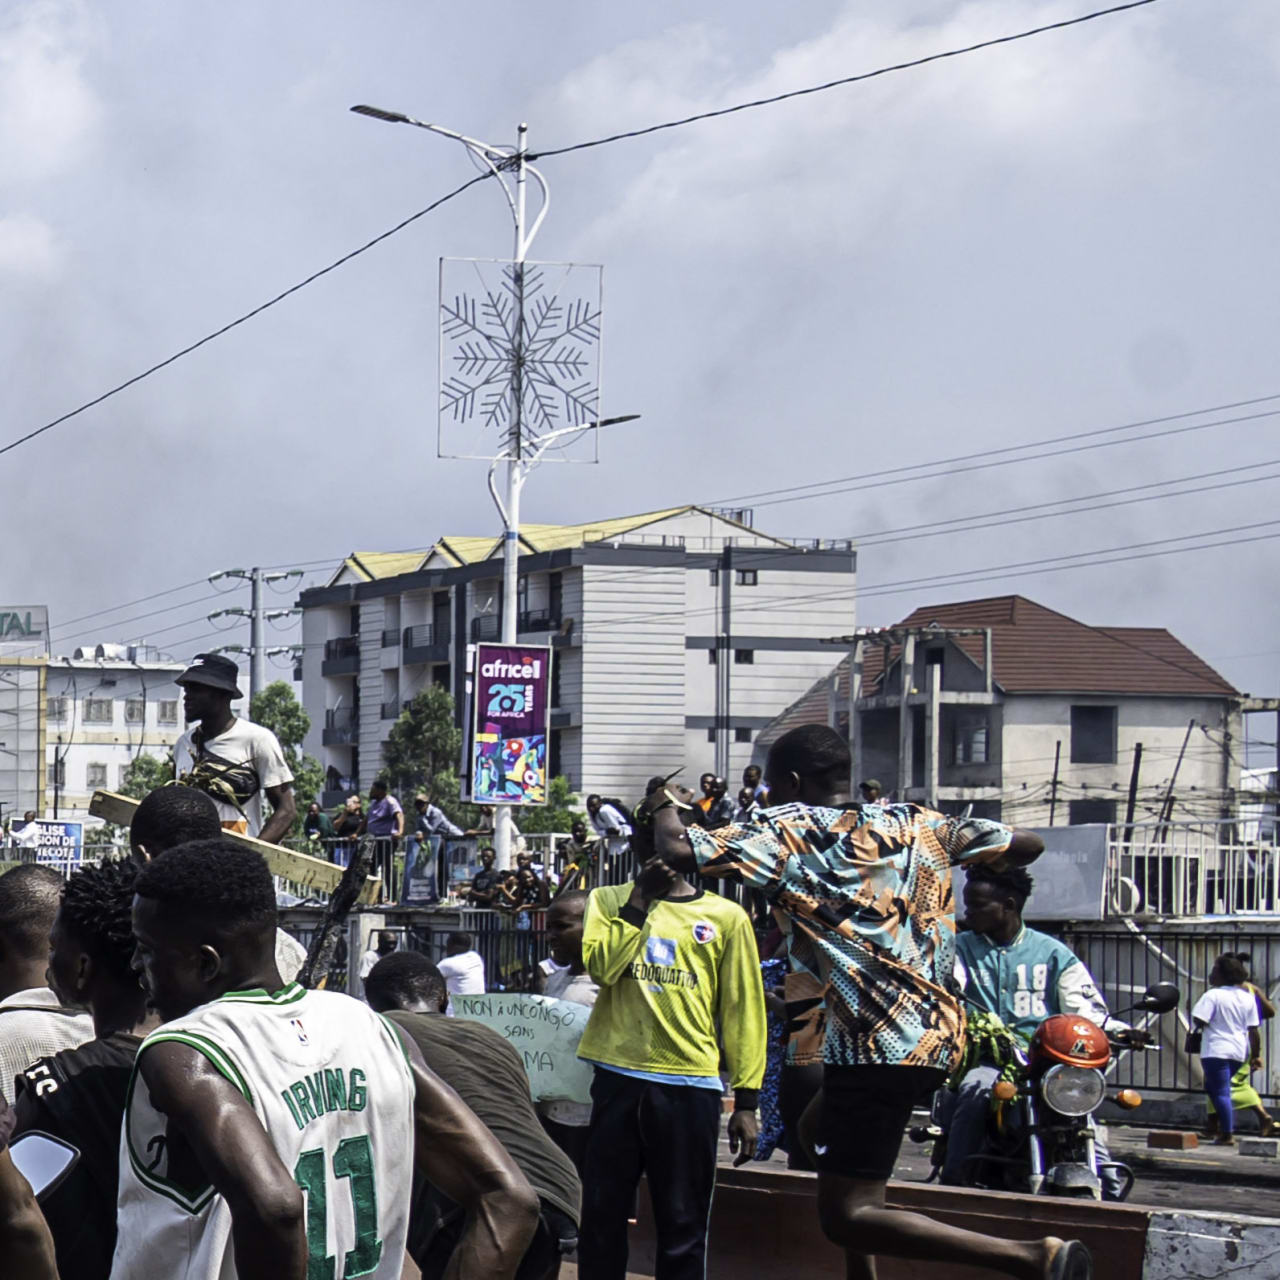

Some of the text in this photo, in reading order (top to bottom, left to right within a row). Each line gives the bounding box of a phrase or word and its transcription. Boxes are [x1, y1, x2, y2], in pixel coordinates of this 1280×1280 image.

[481, 659, 541, 679] africell
[487, 683, 525, 713] 25
[525, 684, 534, 713] YEARS
[462, 999, 493, 1017] NON
[1014, 988, 1046, 1018] 86
[504, 1025, 535, 1040] SANS
[524, 1050, 554, 1072] MA
[281, 1068, 367, 1131] IRVING
